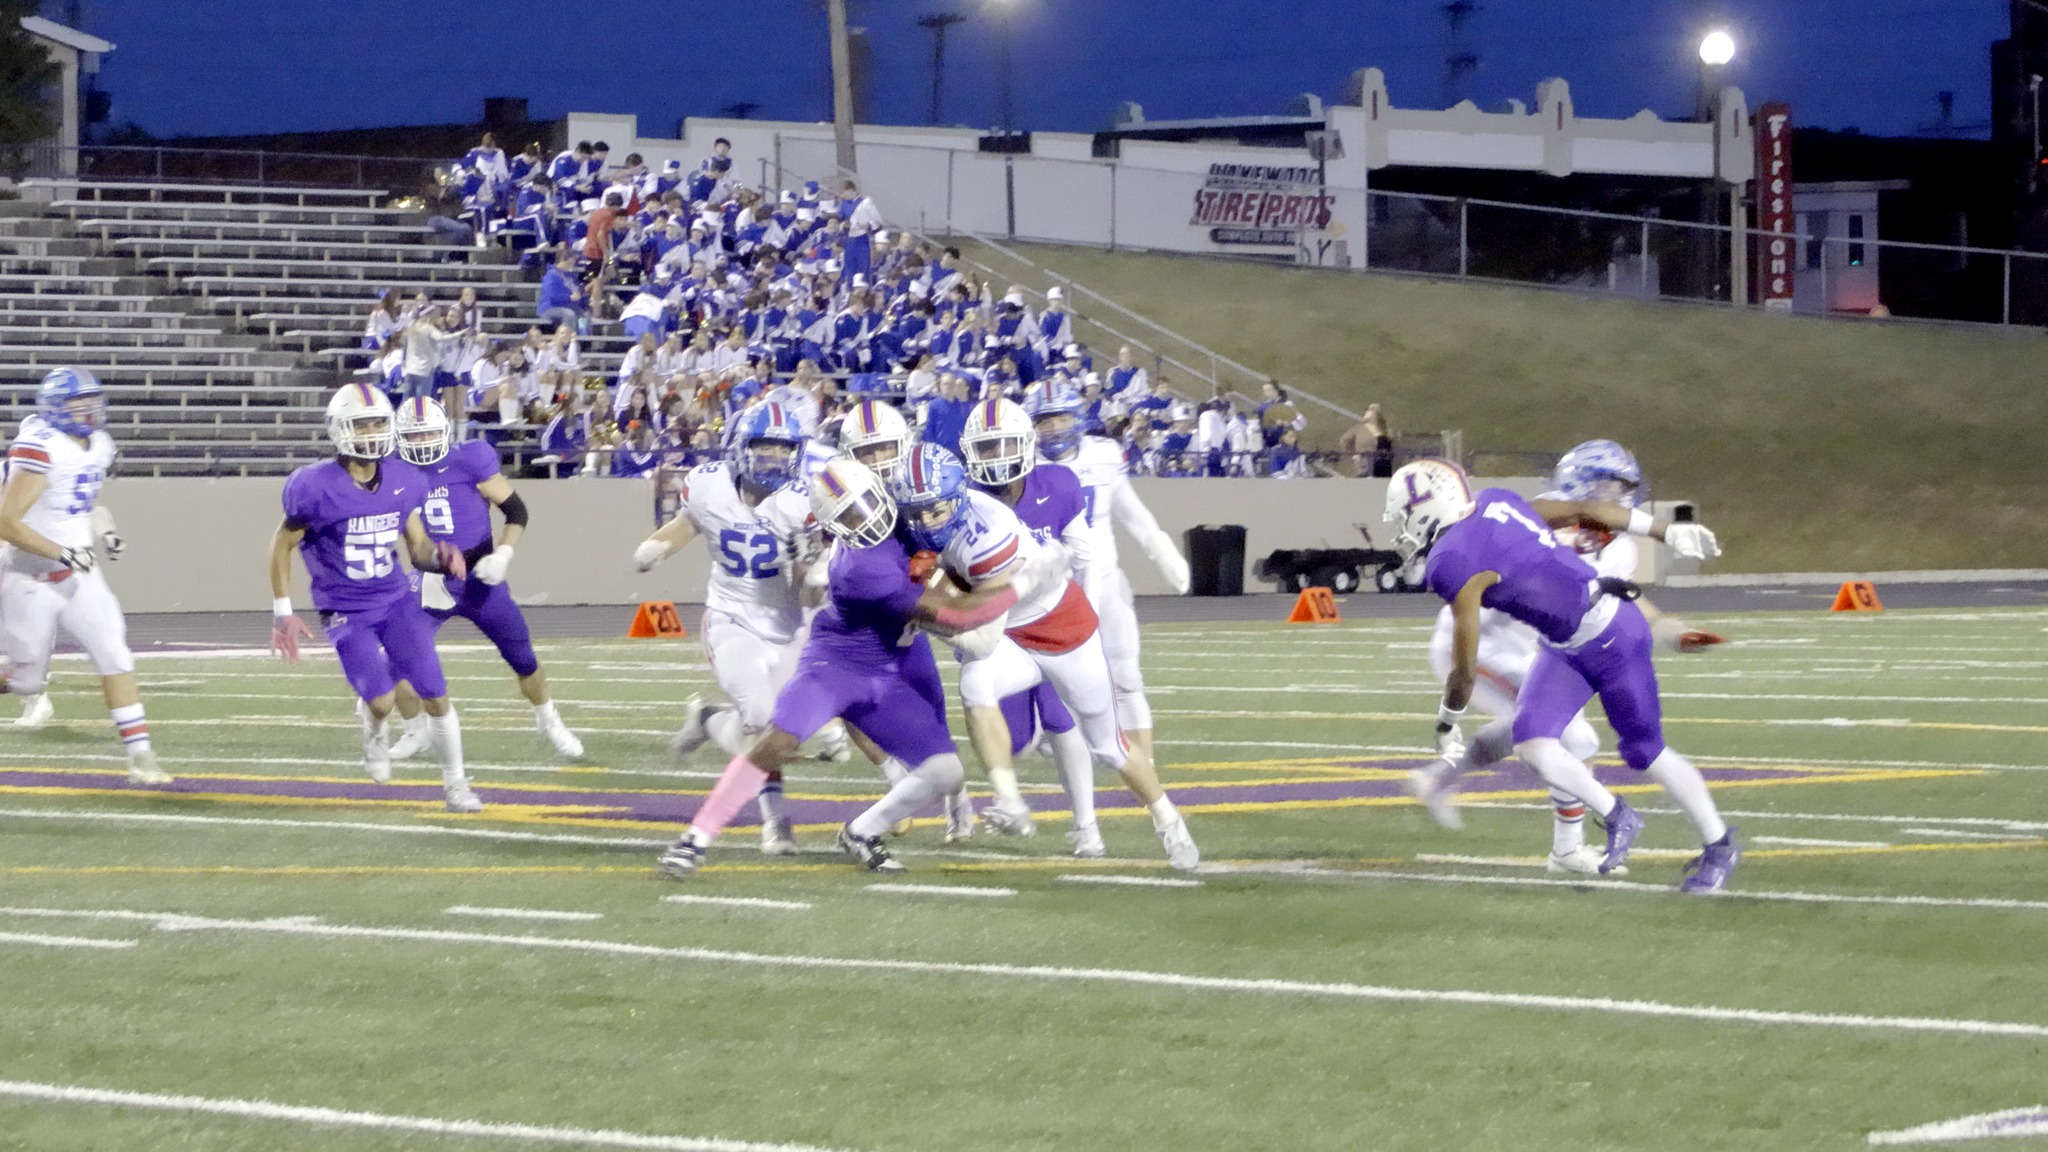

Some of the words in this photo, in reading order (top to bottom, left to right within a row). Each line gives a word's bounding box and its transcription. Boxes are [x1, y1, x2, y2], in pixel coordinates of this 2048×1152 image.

[1767, 113, 1788, 294] Firestone
[719, 528, 779, 580] 52
[965, 520, 990, 548] 24
[344, 529, 400, 580] 55
[649, 604, 682, 633] 20
[1311, 591, 1337, 619] 10
